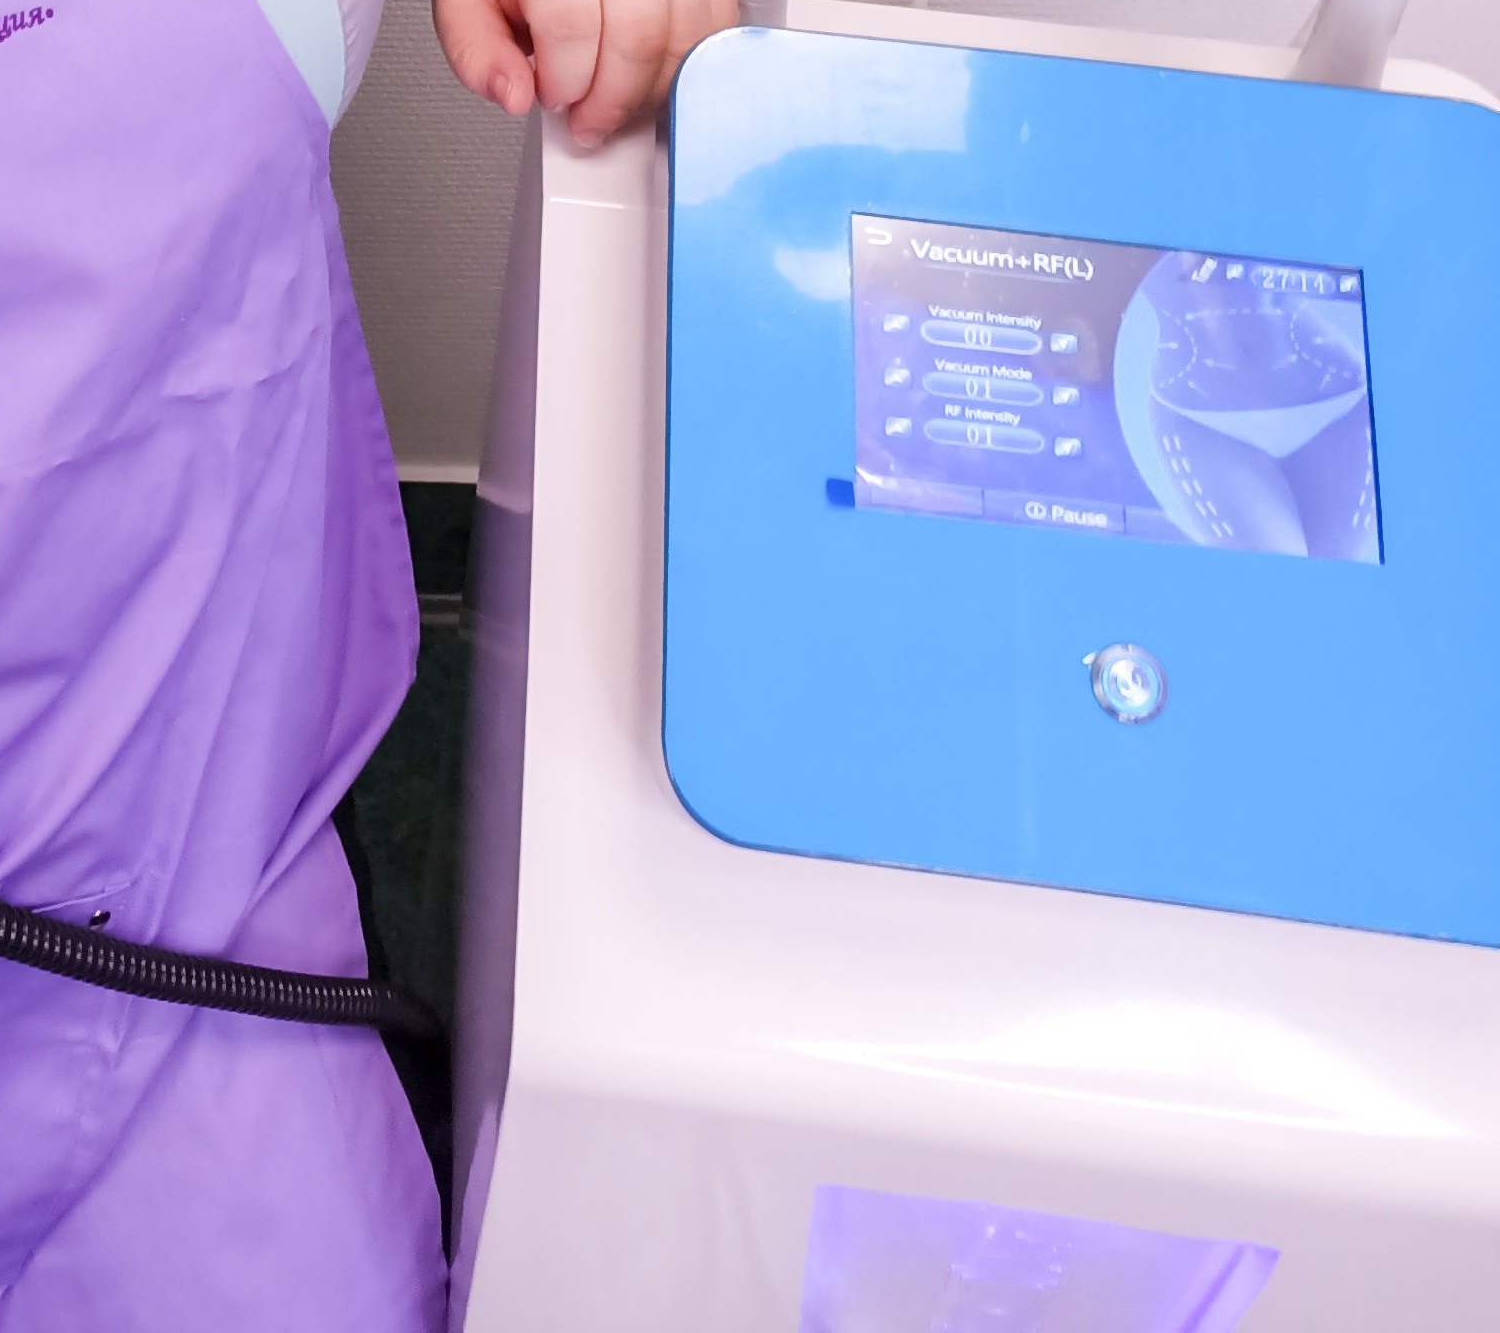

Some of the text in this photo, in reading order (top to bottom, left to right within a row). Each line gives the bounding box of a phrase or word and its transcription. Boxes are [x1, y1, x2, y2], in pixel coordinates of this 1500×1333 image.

[910, 238, 1095, 282] Vacuum+RF(L)
[928, 304, 1042, 331] Vacuum Intensity
[934, 358, 1033, 381] Vacuum Mode
[1051, 504, 1108, 528] Pause
